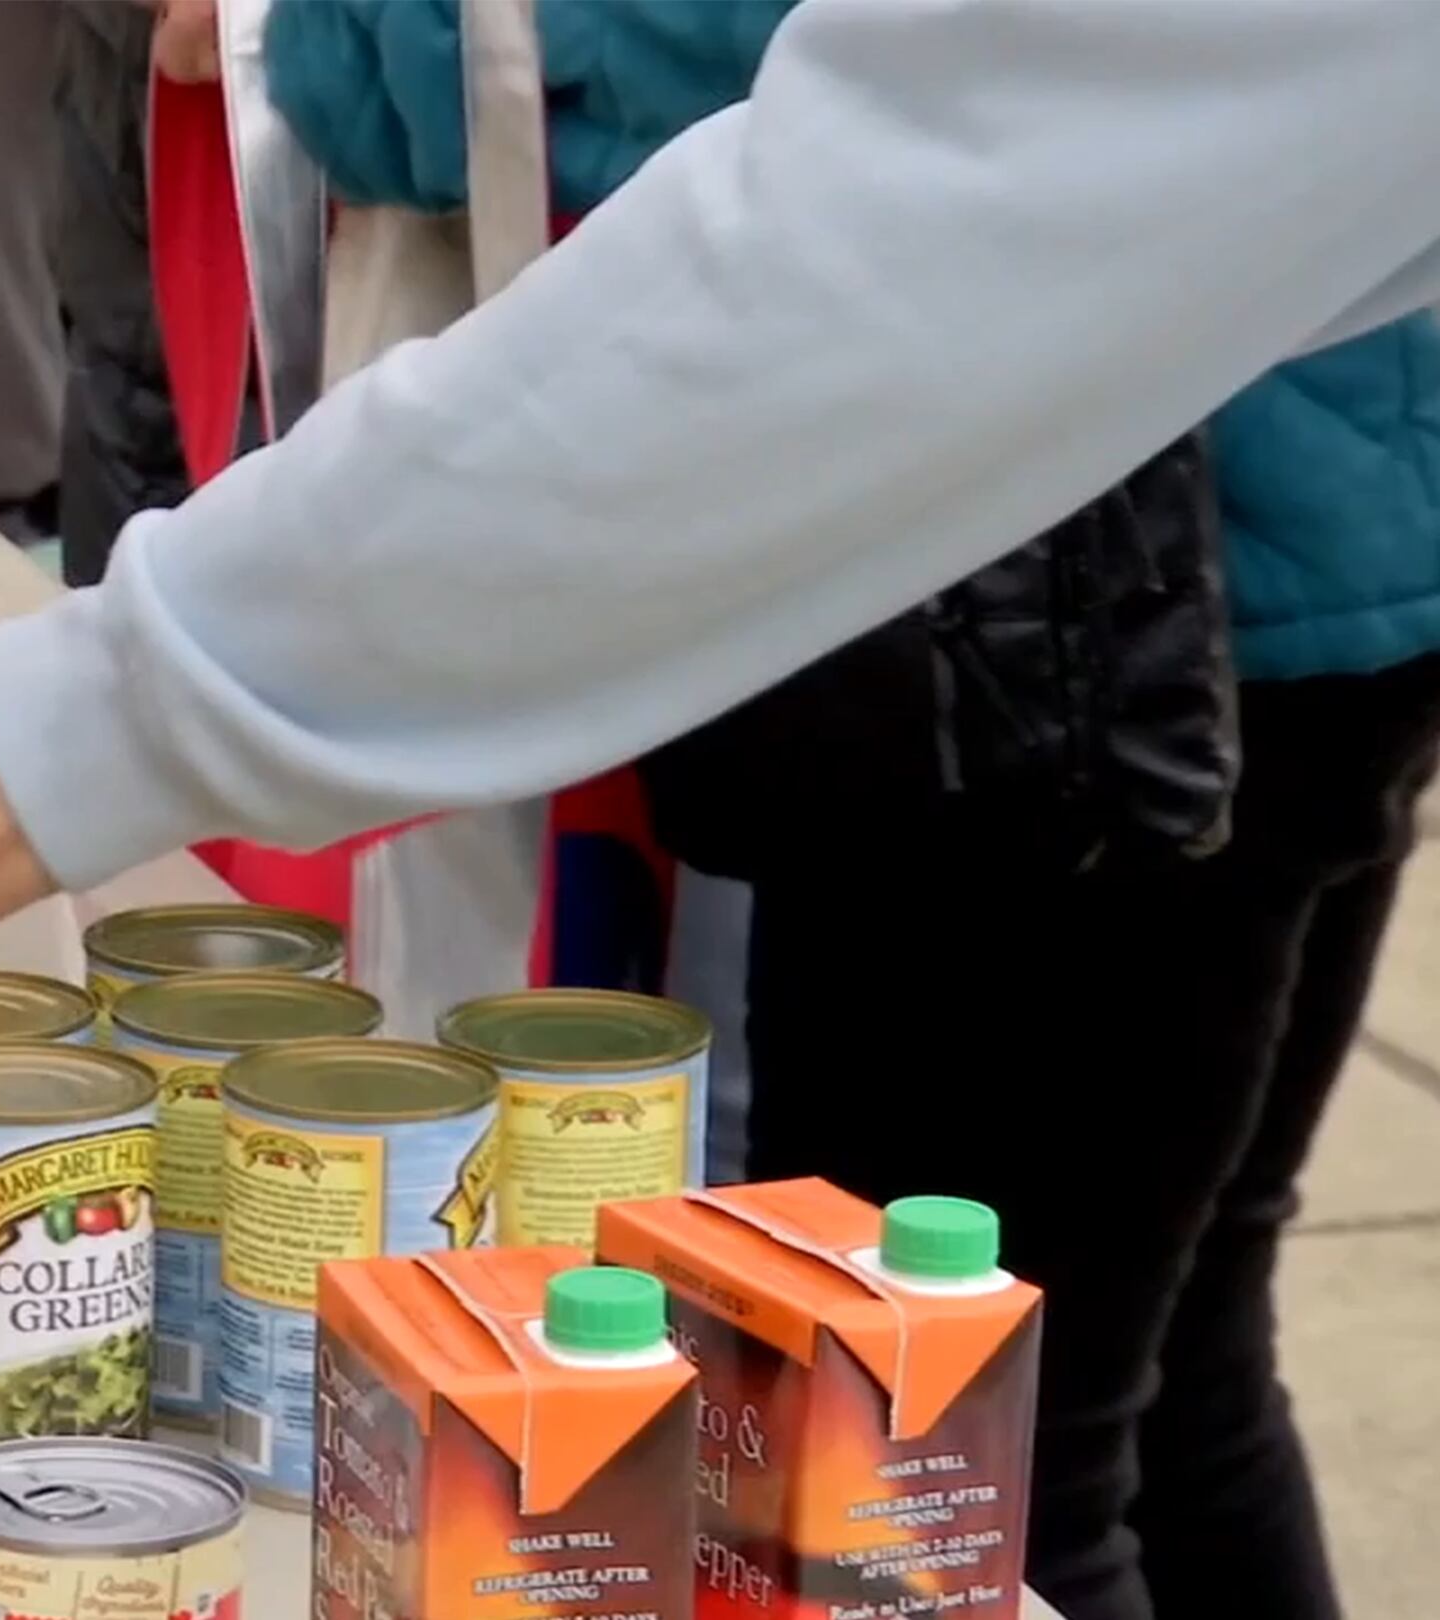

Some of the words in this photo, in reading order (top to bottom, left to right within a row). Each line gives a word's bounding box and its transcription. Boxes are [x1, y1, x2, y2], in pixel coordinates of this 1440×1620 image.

[737, 1405, 766, 1469] &
[924, 1454, 968, 1472] WELL
[948, 1485, 998, 1506] AFTER
[509, 1533, 563, 1554] SHAKE
[566, 1531, 615, 1549] WELL
[474, 1568, 588, 1595] REFRIGERATE
[590, 1565, 650, 1585] AFTER
[695, 1533, 775, 1608] epper
[860, 1560, 908, 1581] AFTER
